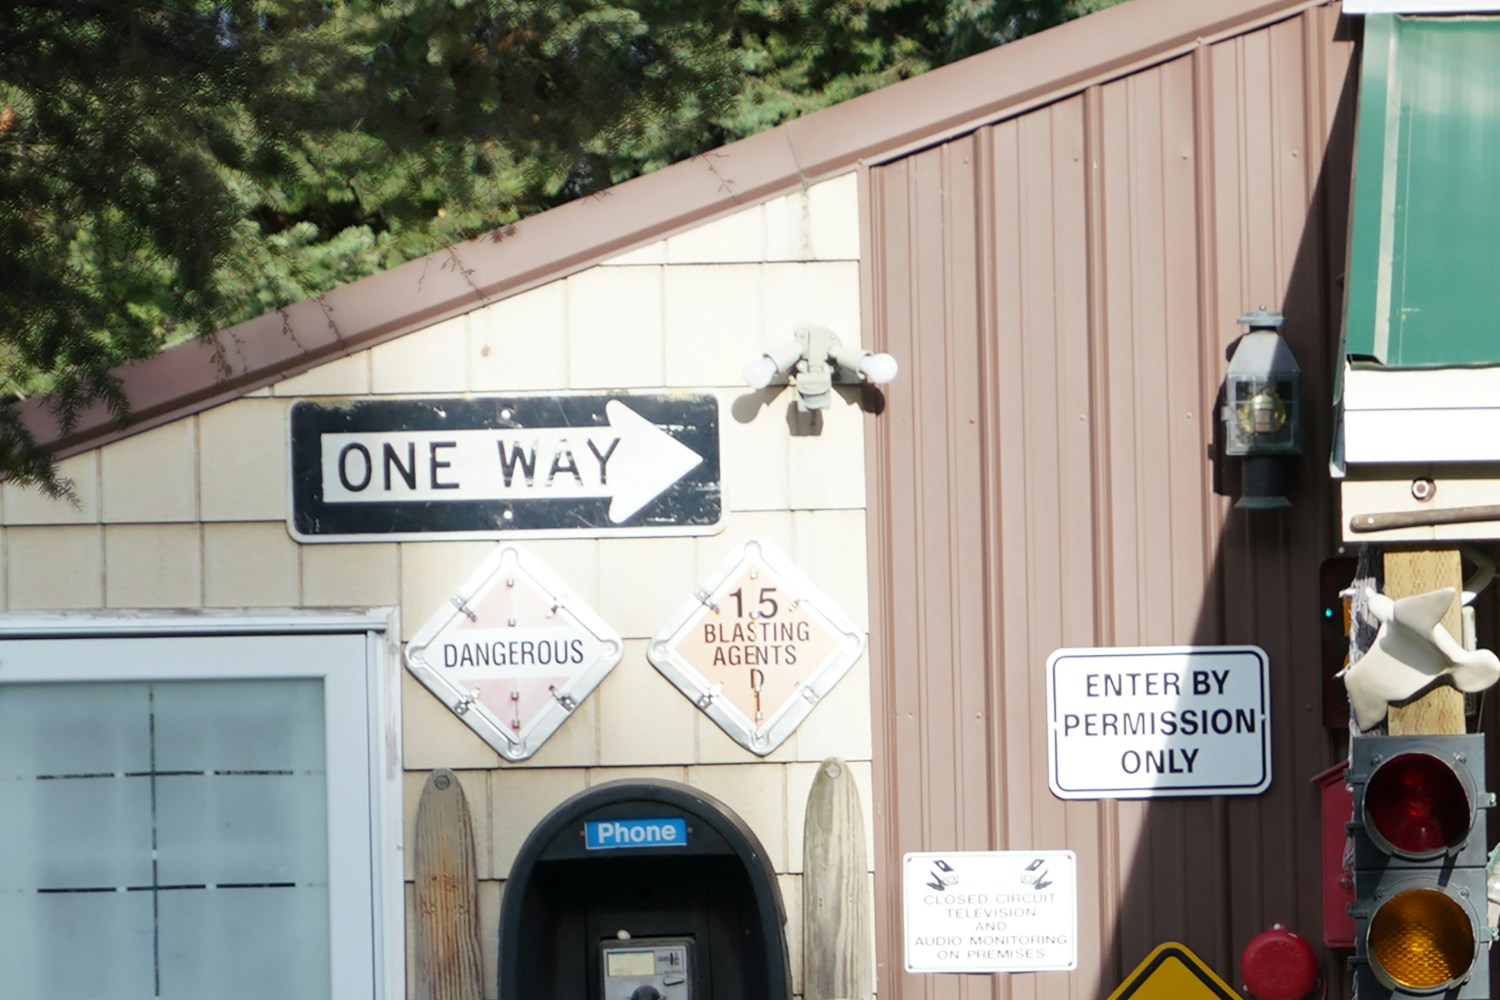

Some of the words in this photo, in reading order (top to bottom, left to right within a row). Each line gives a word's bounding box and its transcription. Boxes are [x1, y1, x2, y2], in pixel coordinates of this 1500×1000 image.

[338, 439, 460, 494] ONE
[494, 436, 622, 488] WAY
[704, 621, 810, 643] BLASTING
[443, 639, 584, 669] DANGEROUS
[713, 645, 797, 667] AGENTS
[1086, 672, 1182, 697] ENTER
[1192, 669, 1231, 696] BY
[1063, 708, 1256, 737] PERMISSION
[1121, 748, 1200, 774] ONLY
[597, 822, 677, 844] Phone
[923, 893, 988, 905] CLOSED
[996, 892, 1057, 904] CIRCUIT
[946, 907, 1037, 919] TELEVISION
[975, 921, 1008, 932] AND
[915, 935, 963, 947] AUDIO
[969, 934, 1068, 946] MONITORING
[937, 949, 960, 960] ON
[967, 947, 1046, 960] PREMISES
